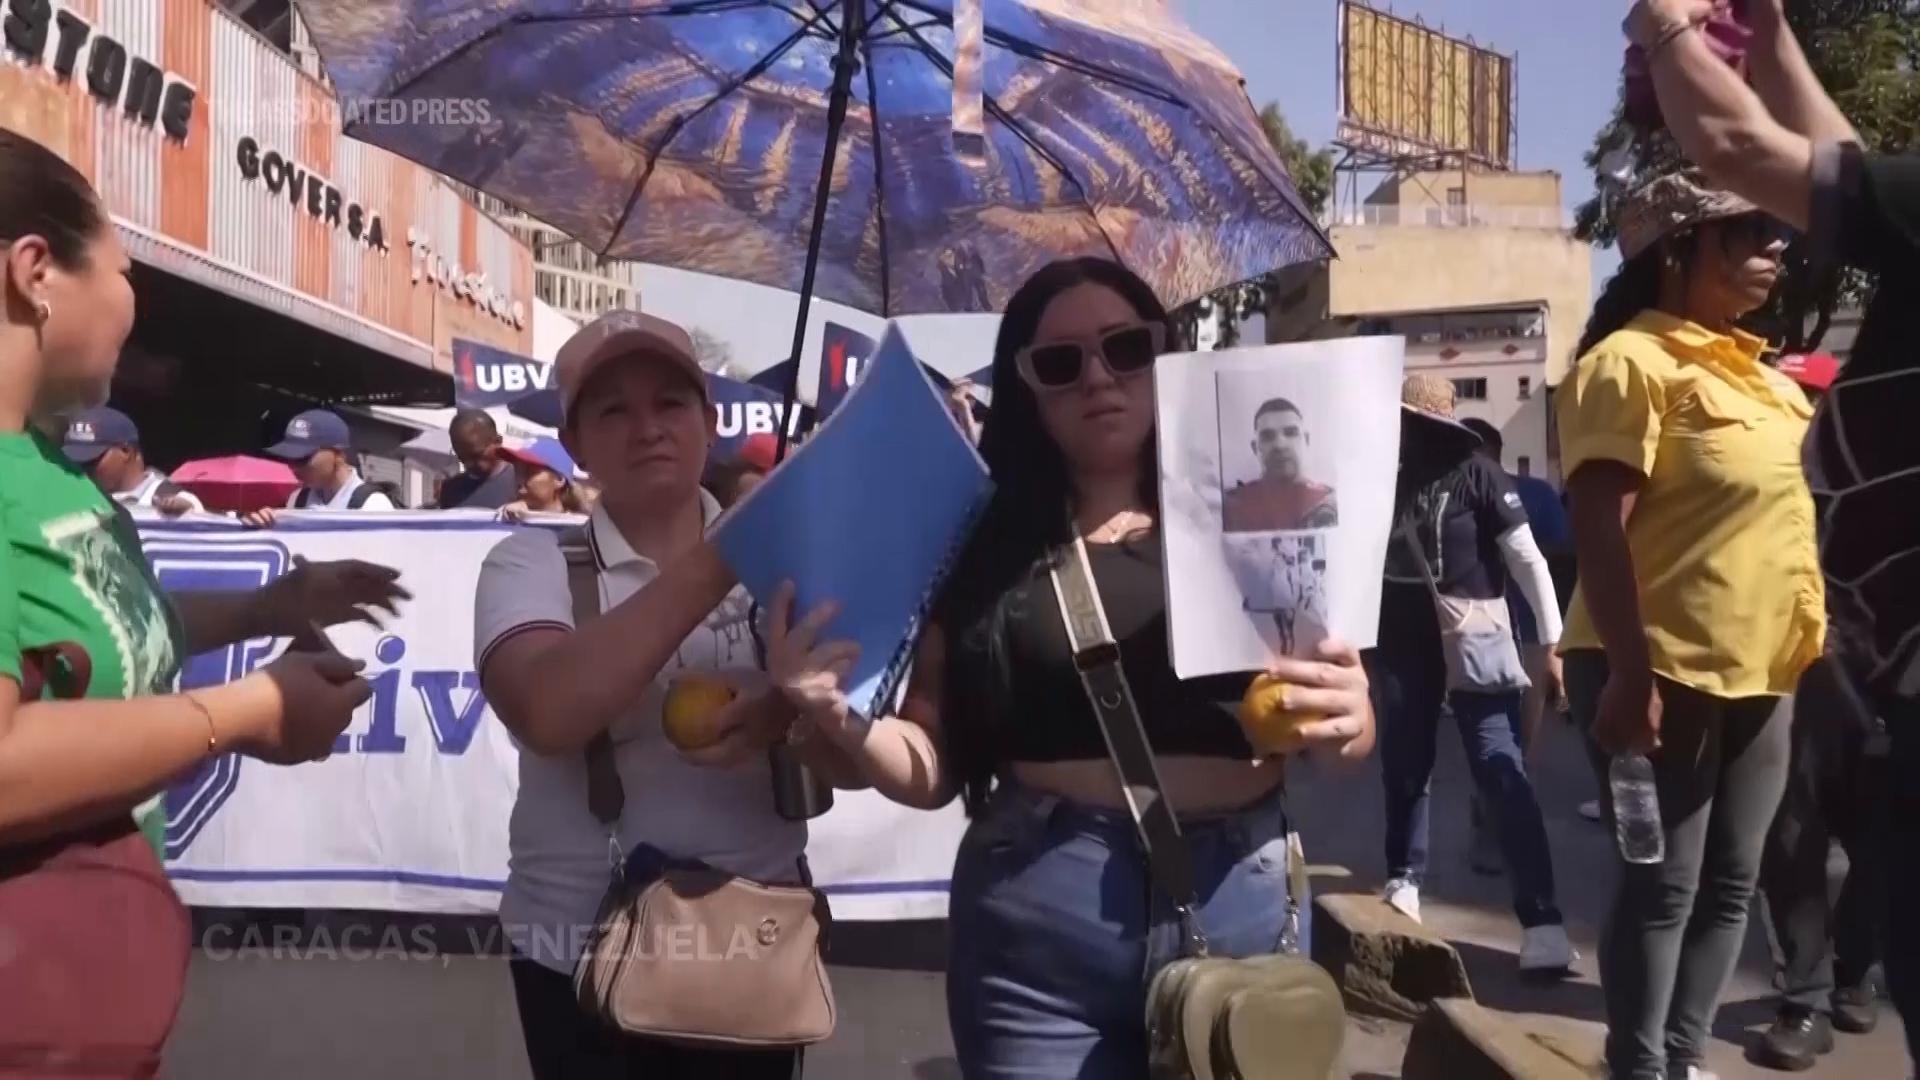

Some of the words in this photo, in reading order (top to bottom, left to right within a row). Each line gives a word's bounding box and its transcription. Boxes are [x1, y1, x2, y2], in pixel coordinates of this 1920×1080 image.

[237, 135, 341, 229] GOVER
[475, 363, 551, 392] UBV
[715, 401, 802, 438] UBV
